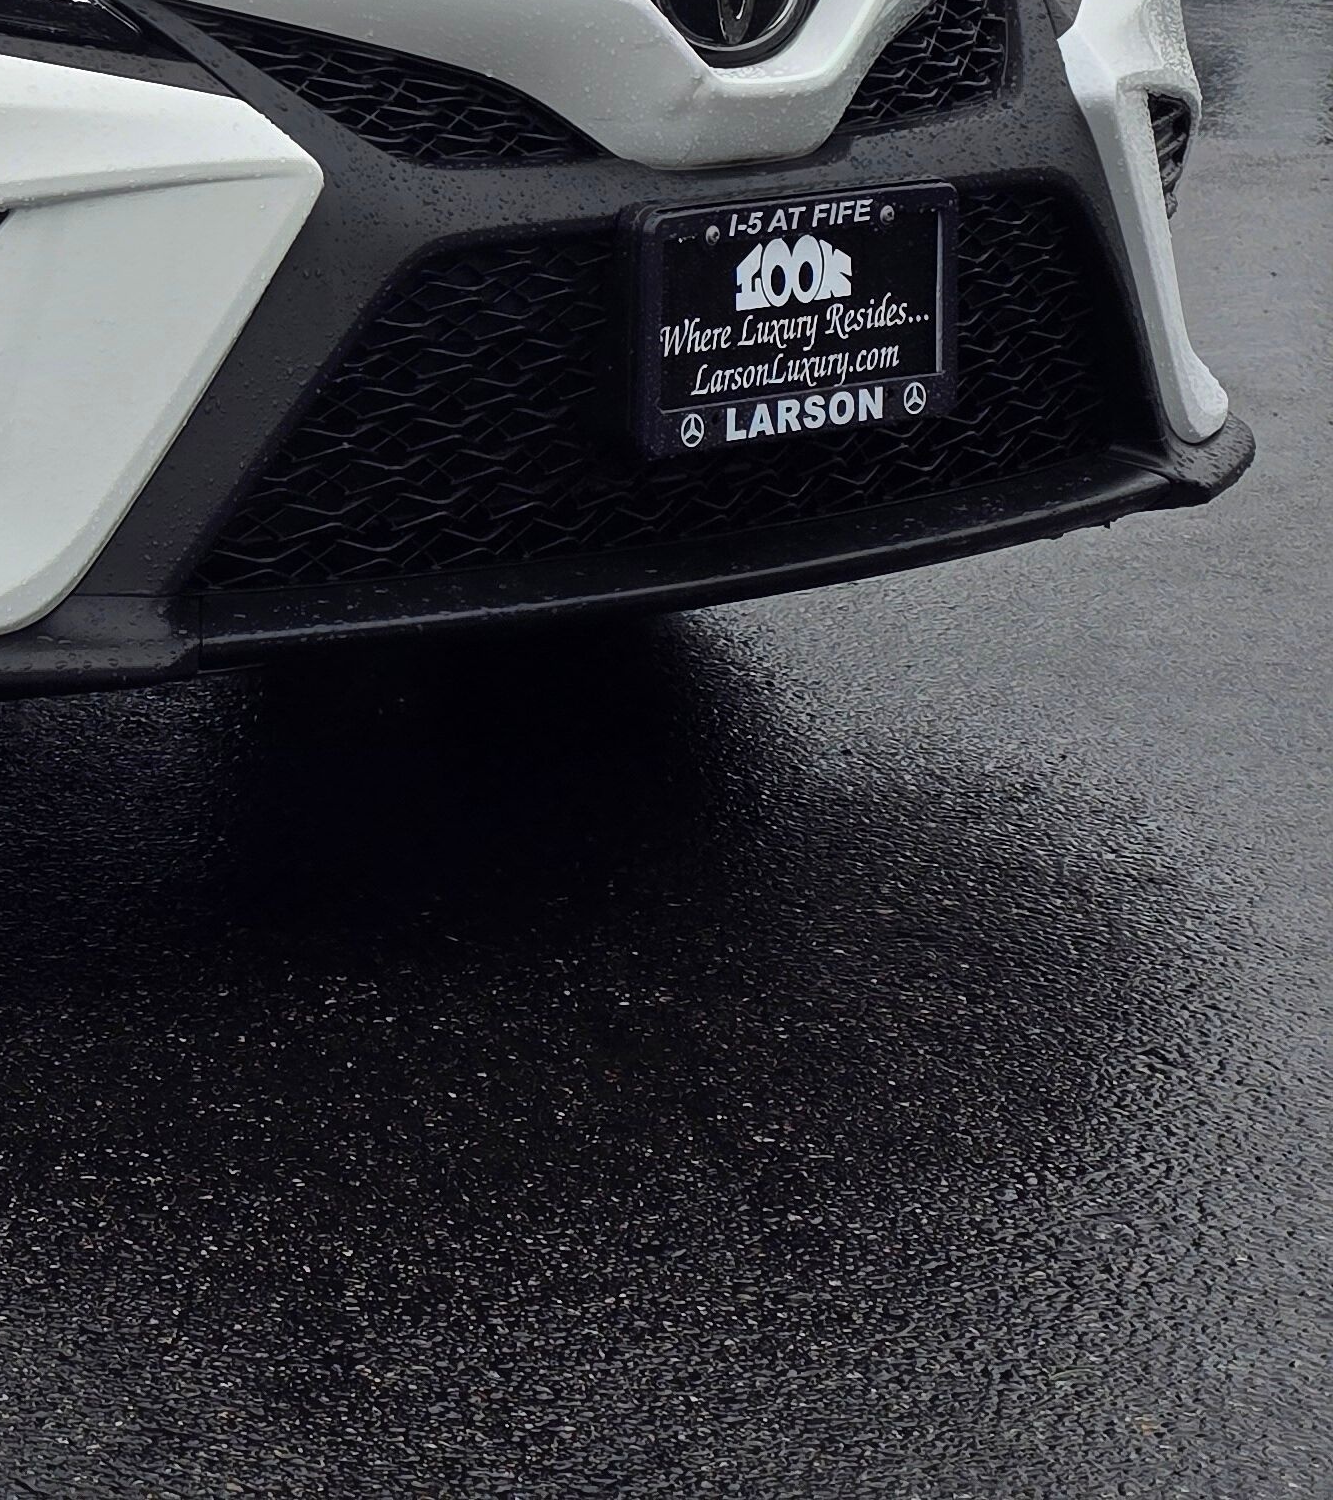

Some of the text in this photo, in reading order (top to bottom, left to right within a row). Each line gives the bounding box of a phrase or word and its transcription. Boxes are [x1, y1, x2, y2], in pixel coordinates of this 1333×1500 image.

[728, 198, 874, 237] I-5 AT FIFE
[660, 292, 930, 358] Where Luxury Resides...
[690, 344, 900, 396] LarsonLuxury.com
[725, 386, 884, 442] LARSON
